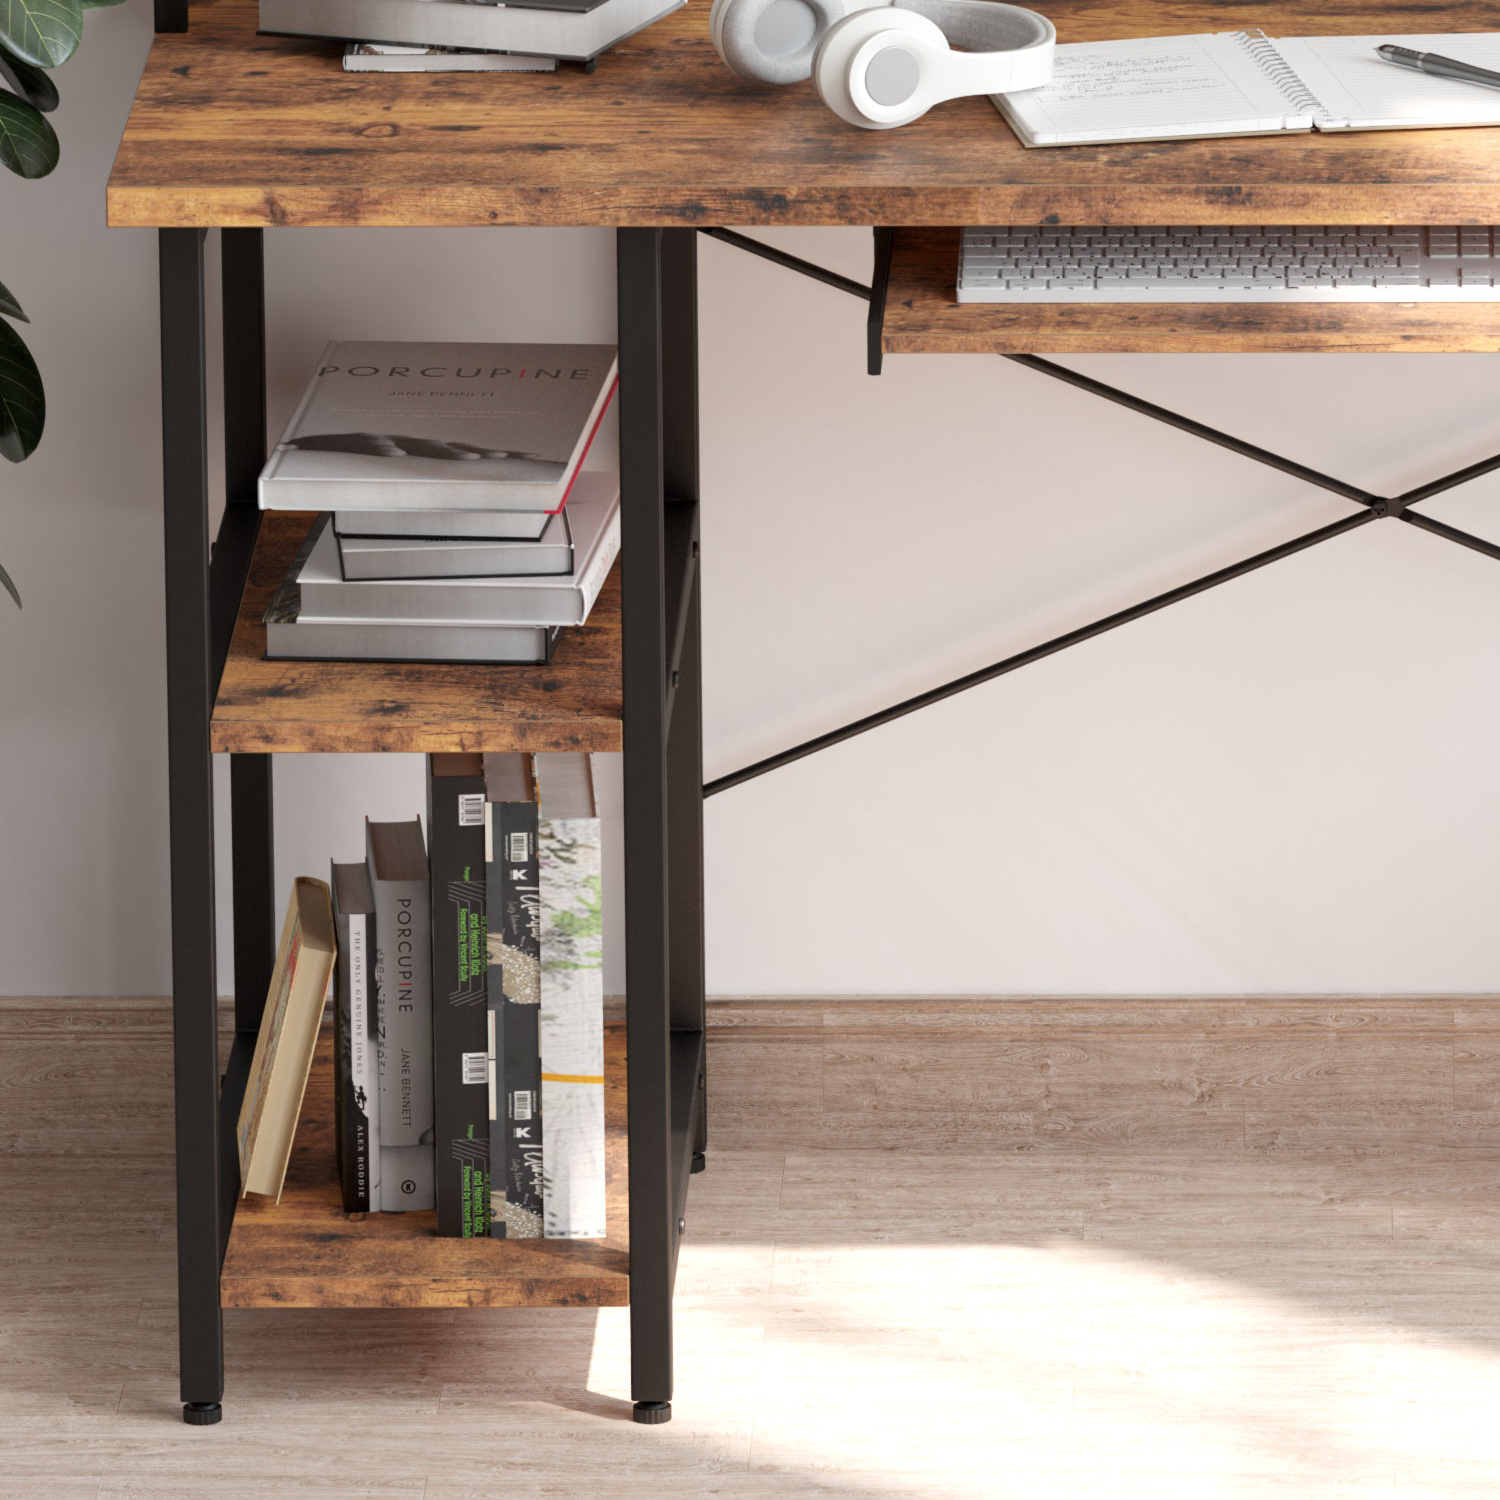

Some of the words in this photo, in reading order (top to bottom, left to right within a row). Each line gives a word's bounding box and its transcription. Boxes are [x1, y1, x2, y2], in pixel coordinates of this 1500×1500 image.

[318, 366, 590, 380] PORCUPINE
[354, 930, 362, 951] THE
[470, 929, 480, 958] Heinrich
[397, 898, 413, 1012] PORCUPINE
[355, 1042, 363, 1075] JONES
[400, 1048, 411, 1074] JANE
[401, 1078, 412, 1128] BENNETT
[357, 1125, 365, 1152] ALEX
[357, 1157, 365, 1198] RODDIE
[474, 1187, 484, 1215] Heinrich
